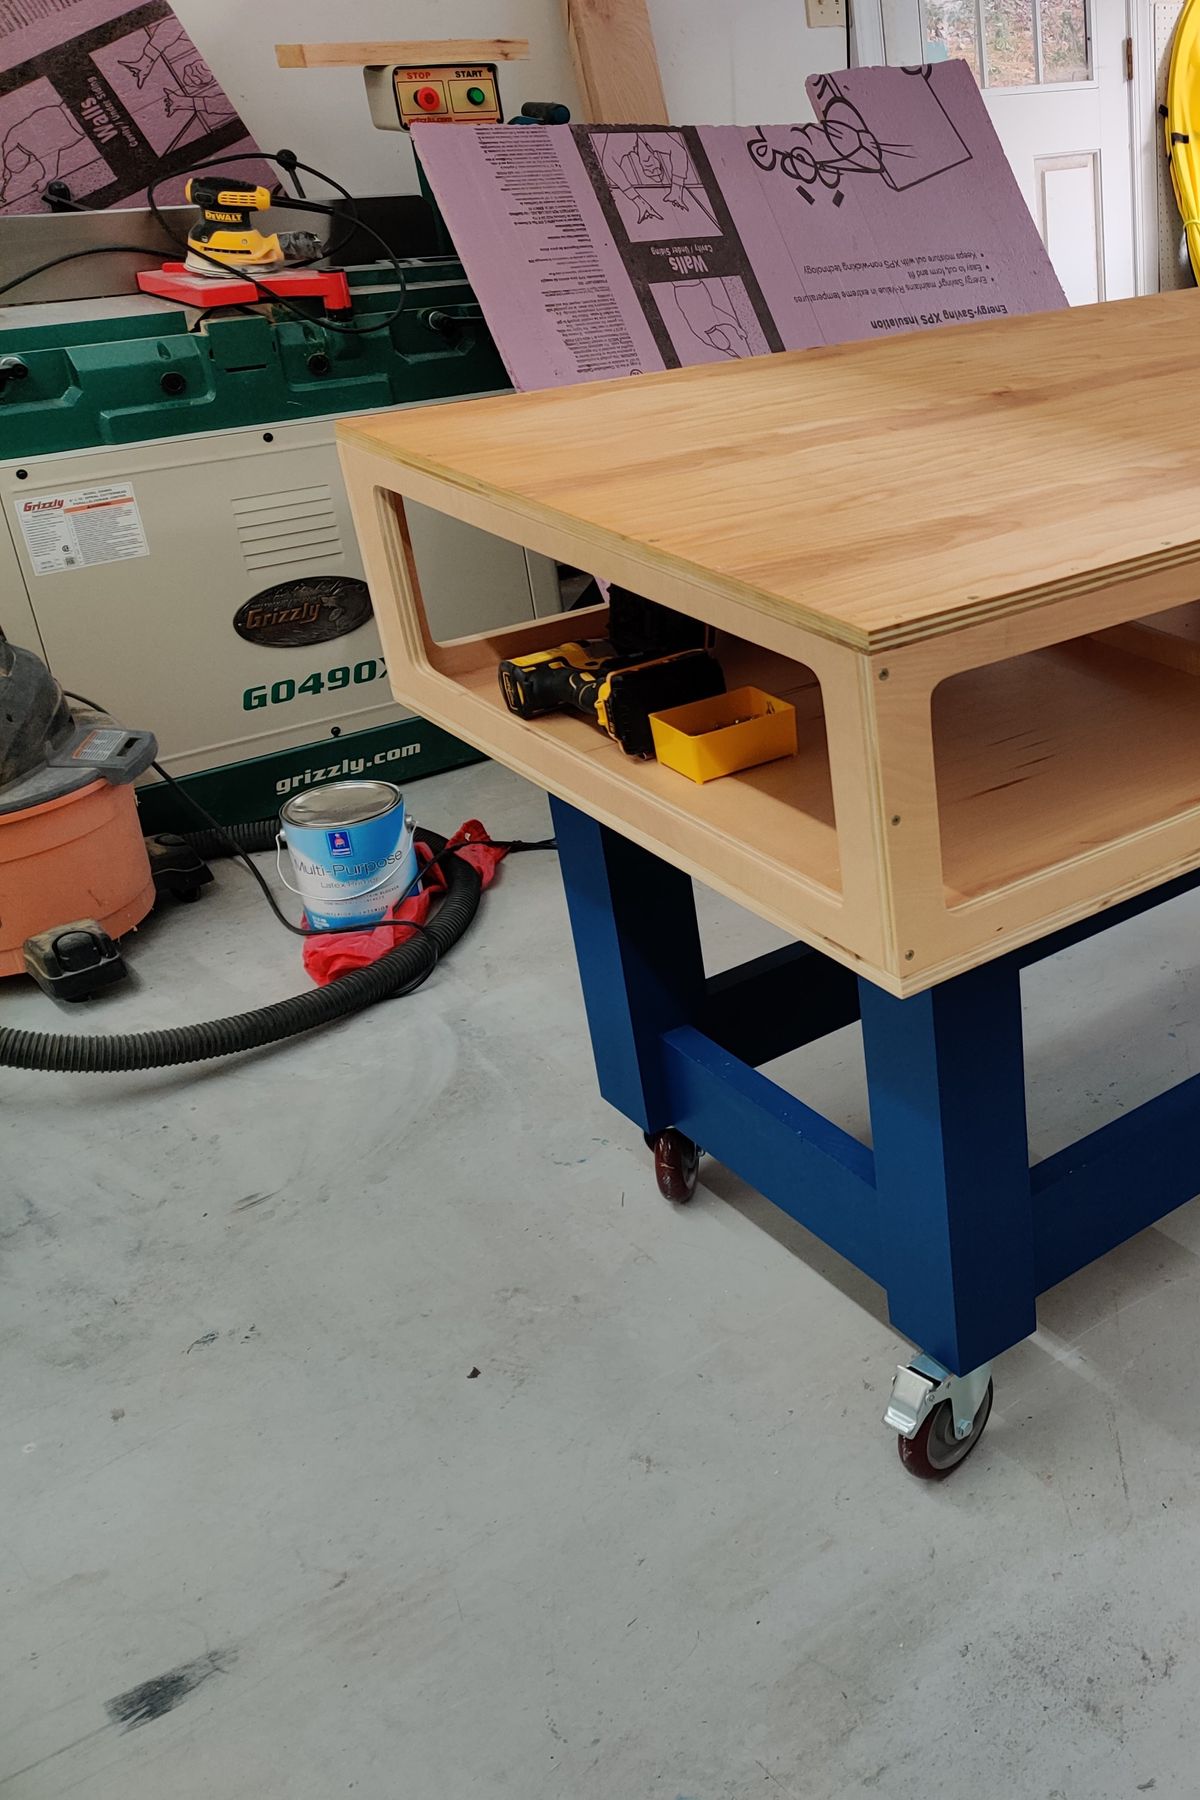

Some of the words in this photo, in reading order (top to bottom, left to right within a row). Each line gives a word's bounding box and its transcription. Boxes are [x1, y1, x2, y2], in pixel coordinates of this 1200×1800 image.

[406, 71, 431, 80] STOP
[455, 70, 484, 78] START
[87, 76, 106, 100] Siding
[103, 100, 120, 121] Under
[81, 97, 118, 144] Walls
[205, 210, 242, 223] DEWALT
[650, 246, 671, 256] Siding
[672, 246, 690, 255] Under
[695, 244, 713, 253] Cavity
[916, 256, 927, 264] out
[928, 253, 955, 262] moisture
[956, 251, 977, 260] Keeps
[668, 255, 709, 274] Walls
[841, 262, 883, 271] non-wicking
[884, 259, 900, 269] XPS
[901, 258, 915, 266] with
[803, 264, 842, 275] technology
[916, 269, 929, 277] and
[967, 264, 982, 272] Easy
[908, 271, 916, 279] fit
[965, 275, 988, 284] Energy
[905, 282, 936, 290] maintains
[794, 291, 842, 303] temperatures
[841, 288, 869, 298] extreme
[942, 305, 1008, 320] Energy-Saving
[870, 315, 919, 330] Insulation
[920, 312, 943, 325] XPS
[23, 499, 64, 512] Grizzly
[246, 601, 321, 630] Grizzly
[275, 743, 421, 795] grizzly.com
[293, 850, 403, 877] Multi-Purpose
